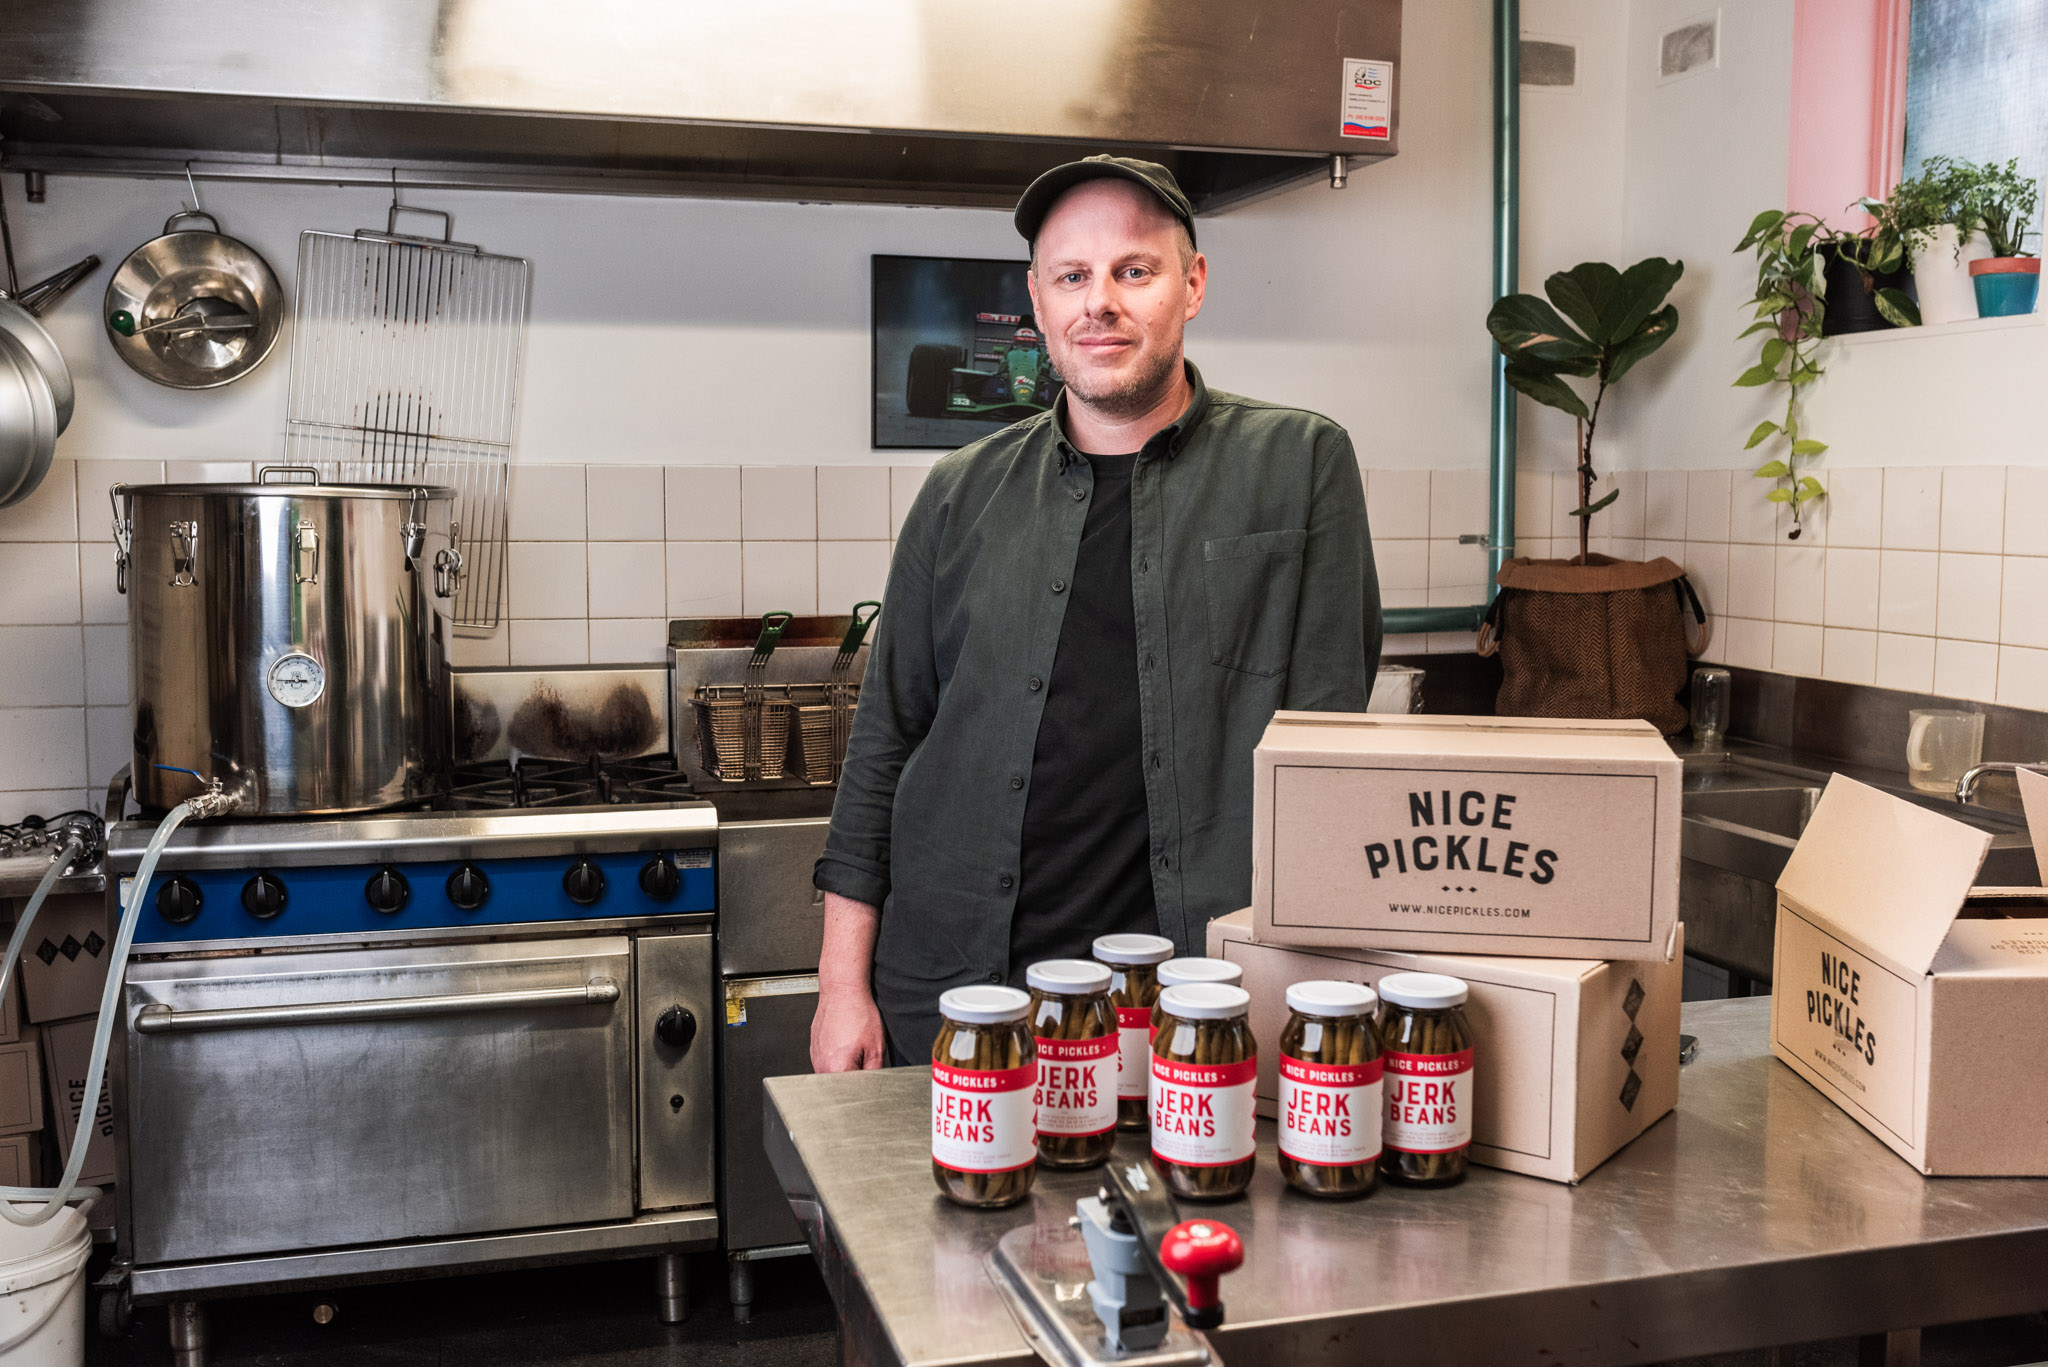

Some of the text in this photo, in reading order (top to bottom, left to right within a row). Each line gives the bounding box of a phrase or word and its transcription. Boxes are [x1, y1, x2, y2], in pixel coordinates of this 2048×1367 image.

[1354, 78, 1382, 86] CDC
[953, 397, 970, 406] 33
[1408, 790, 1517, 831] NICE
[1364, 834, 1559, 885] PICKLES
[1388, 903, 1531, 919] WWW.NICEPICKLES.COM
[1821, 951, 1861, 1006] NICE
[1806, 990, 1876, 1066] PICKLES
[1037, 1043, 1100, 1057] ICE PICKLES
[1154, 1062, 1218, 1083] NICE PICKLES
[1286, 1063, 1355, 1083] NICE PICKLES
[1389, 1057, 1460, 1072] NICE PICKLES
[934, 1067, 997, 1089] NICE PICKLES
[1038, 1065, 1096, 1090] JERK
[1036, 1089, 1098, 1109] BEANS
[1156, 1087, 1214, 1118] JERK
[1287, 1088, 1351, 1118] JERK
[1390, 1080, 1456, 1106] JERK
[936, 1092, 993, 1123] JERK
[1390, 1103, 1457, 1125] BEANS
[936, 1115, 994, 1143] BEANS
[1156, 1109, 1216, 1138] BEANS
[1287, 1110, 1352, 1137] BEANS
